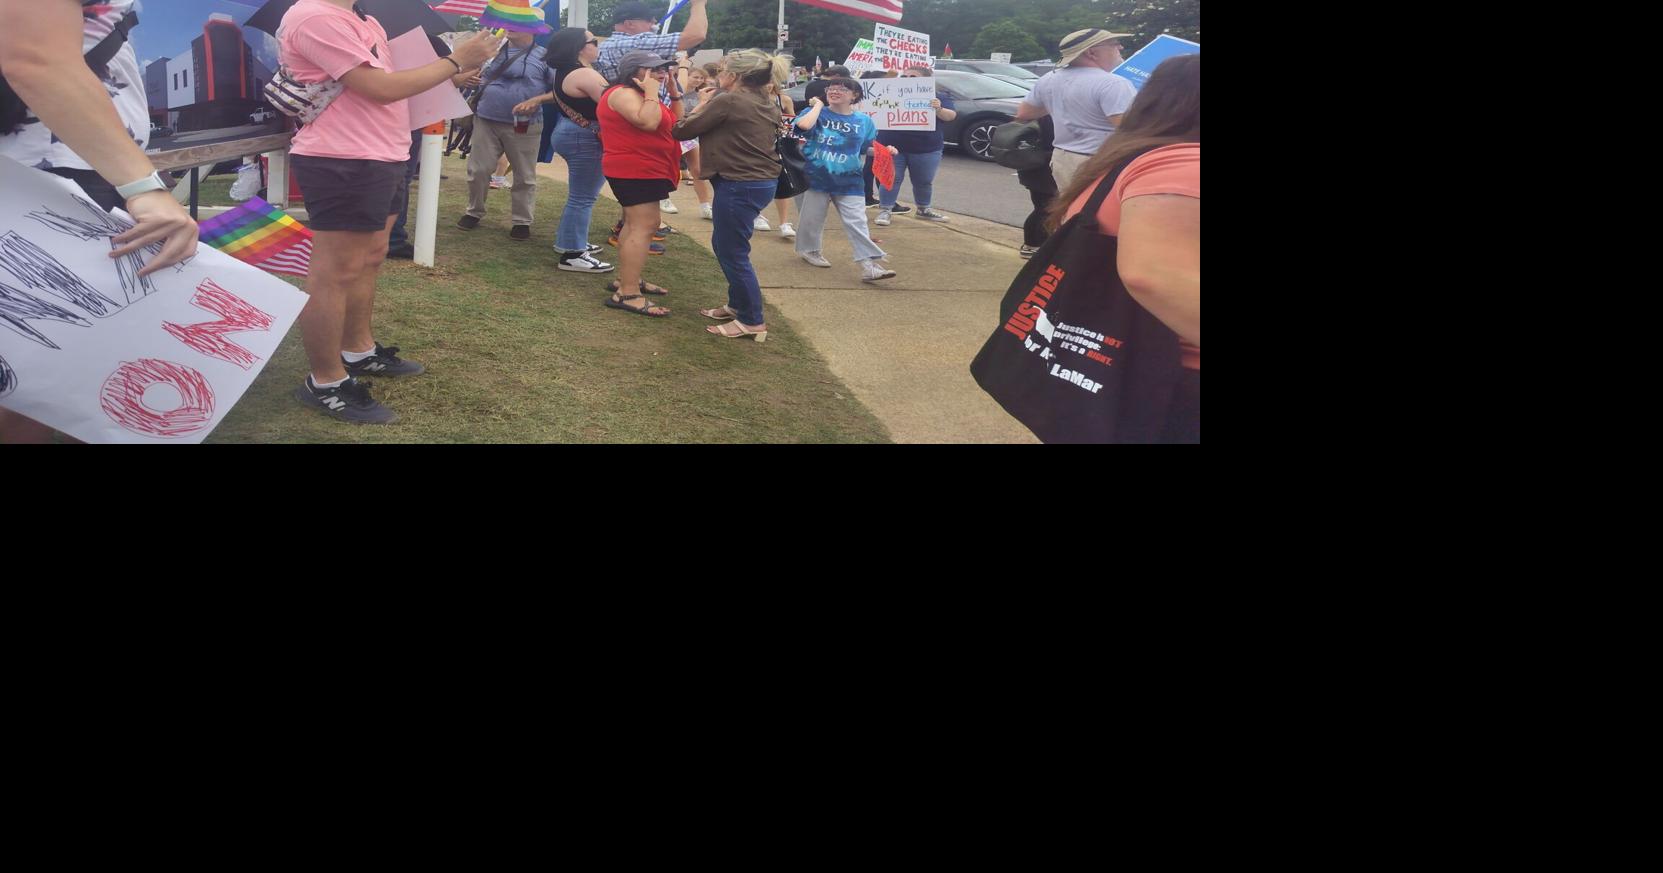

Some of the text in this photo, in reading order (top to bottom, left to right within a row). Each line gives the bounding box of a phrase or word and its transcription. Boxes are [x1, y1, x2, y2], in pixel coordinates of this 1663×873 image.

[889, 38, 928, 54] CHECKS
[907, 35, 928, 45] EATING
[905, 52, 927, 61] EATING
[897, 87, 913, 97] you
[916, 83, 933, 94] have
[872, 100, 899, 109] drunk
[887, 108, 929, 127] plans
[822, 119, 861, 134] JUST
[817, 132, 835, 146] BE
[812, 148, 848, 163] KIND
[1004, 264, 1065, 340] JUSTICE
[1050, 363, 1103, 393] LaMar
